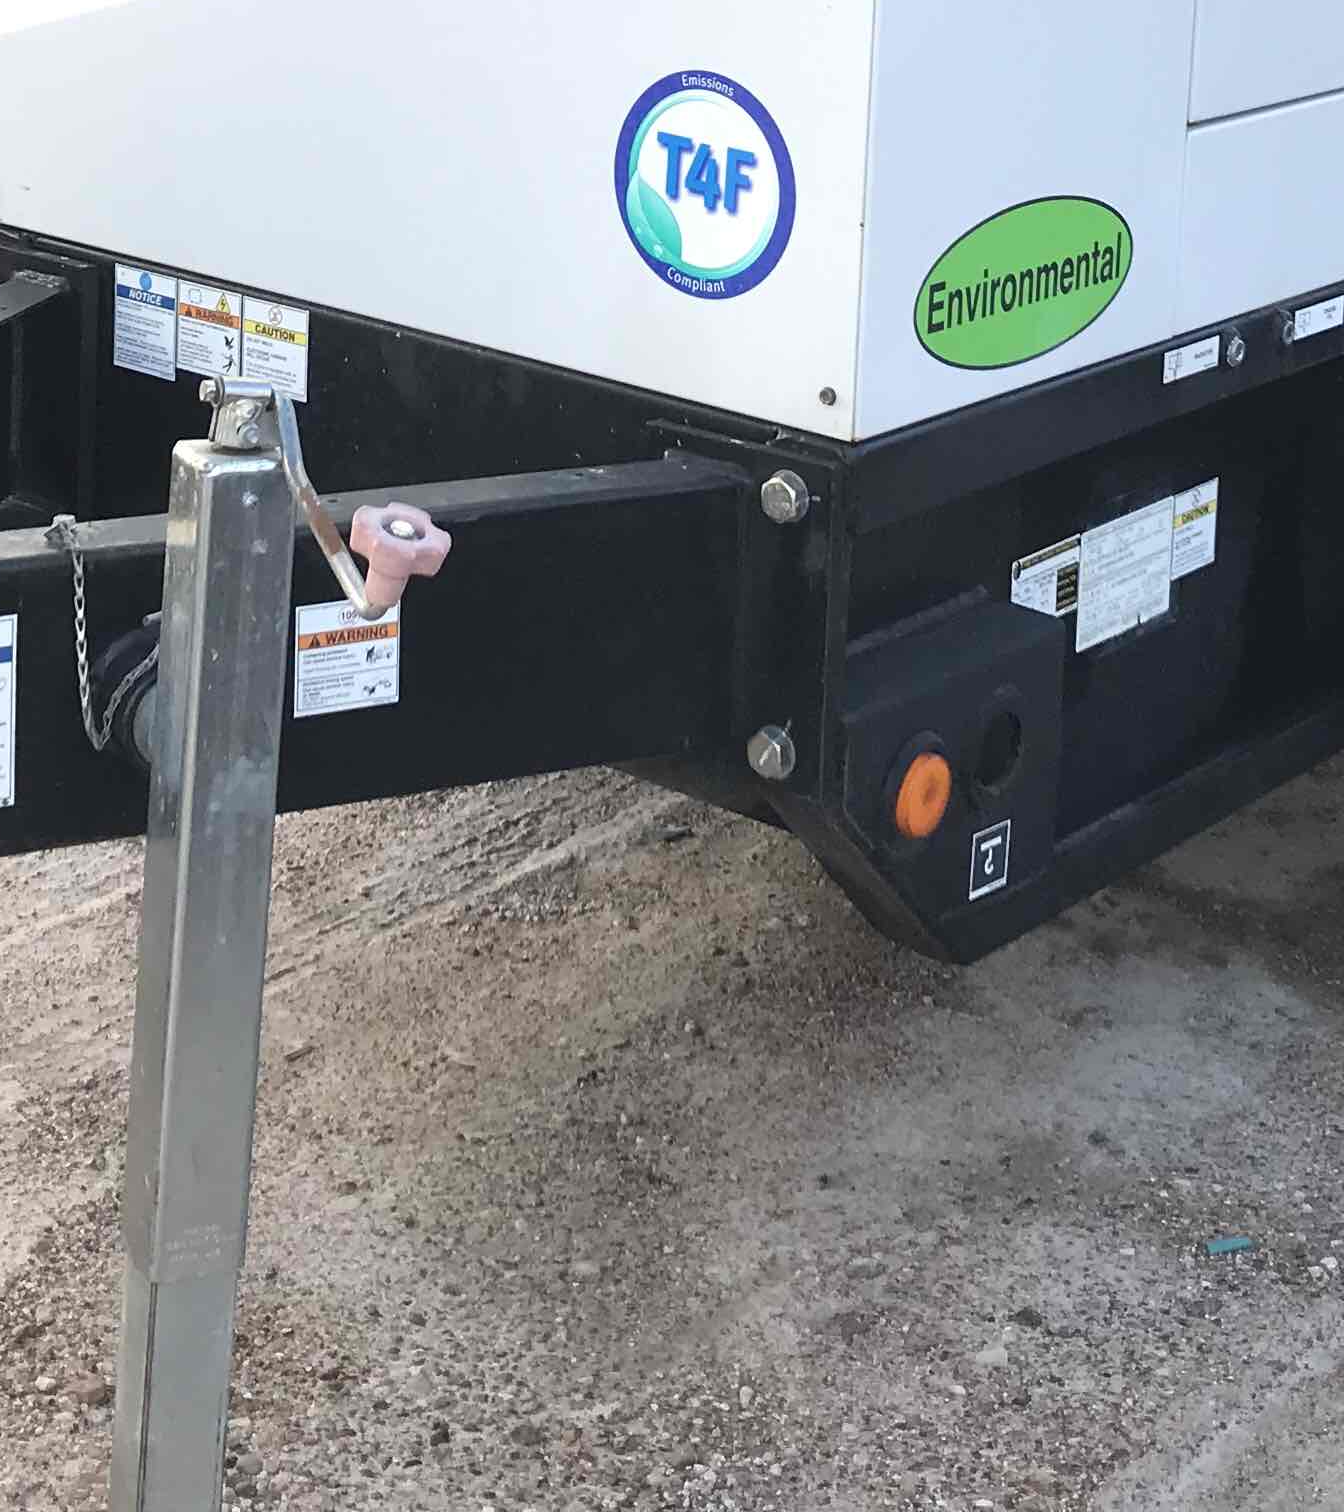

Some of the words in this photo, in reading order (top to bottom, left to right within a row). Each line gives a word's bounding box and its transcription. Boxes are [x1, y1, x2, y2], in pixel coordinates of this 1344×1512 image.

[680, 73, 736, 98] Emissions
[656, 130, 757, 217] T4F
[666, 266, 727, 294] Compliant
[926, 231, 1123, 335] Environmental
[128, 289, 164, 307] NOTICE
[255, 324, 296, 344] CAUTION
[325, 626, 388, 646] WARNING
